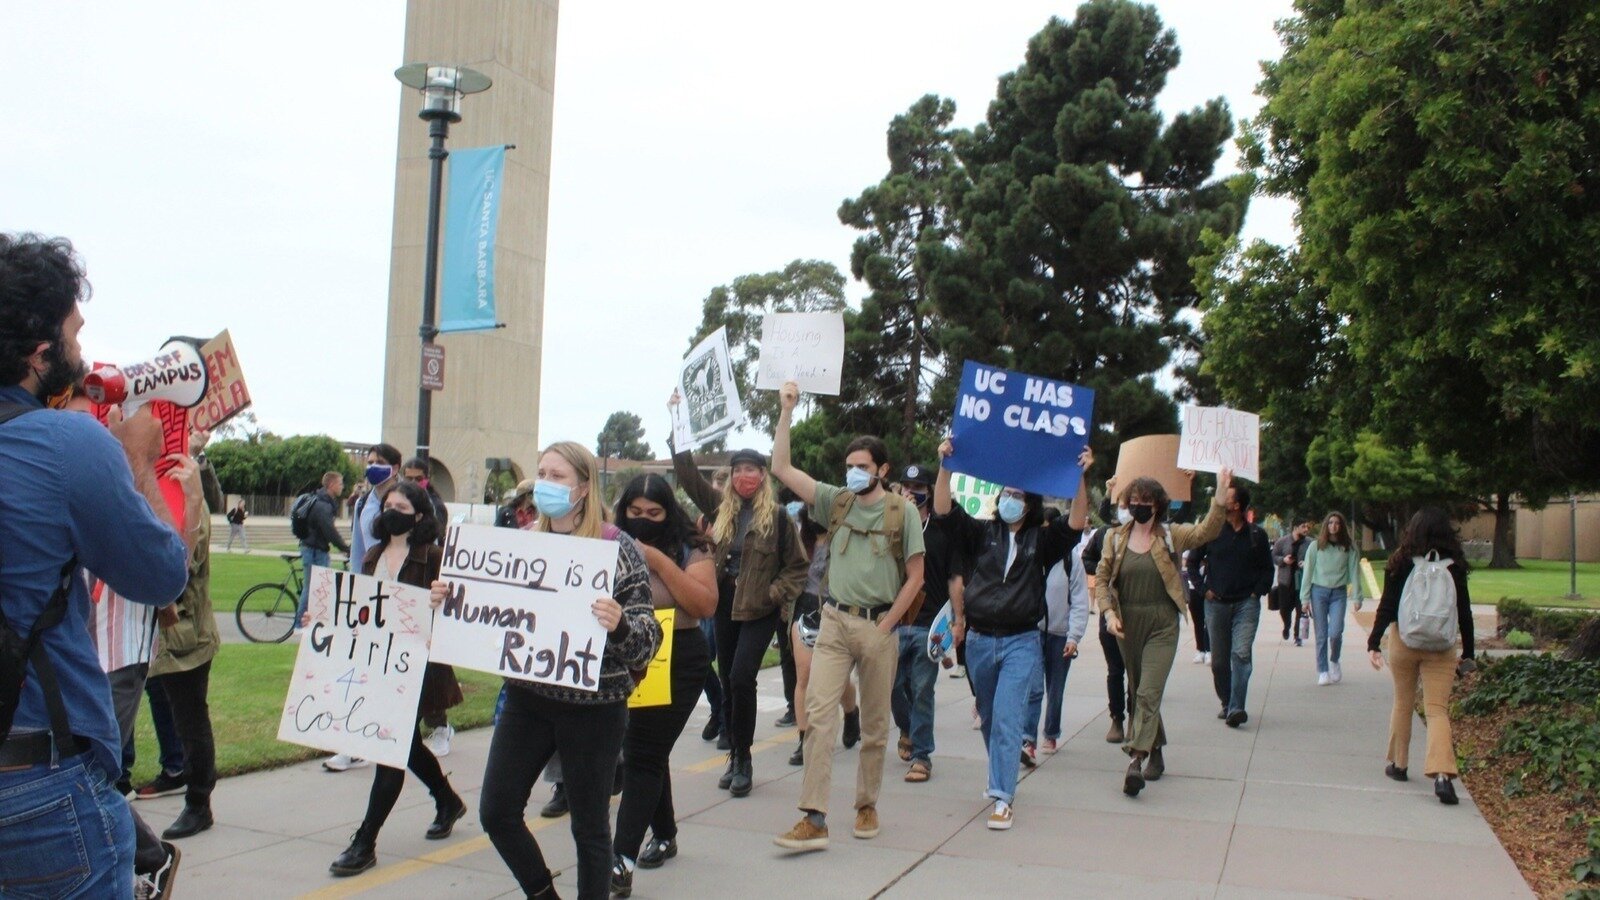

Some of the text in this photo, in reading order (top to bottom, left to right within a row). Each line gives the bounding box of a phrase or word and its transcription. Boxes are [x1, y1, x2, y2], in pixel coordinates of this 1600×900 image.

[477, 169, 495, 309] UC SANTA BARBARA
[770, 320, 821, 348] Housing
[123, 350, 182, 379] COPS OFF
[134, 363, 202, 395] CAMPUS
[974, 368, 1073, 408] UC HAS
[193, 379, 247, 432] COLA
[959, 394, 1086, 437] NO CLASS
[442, 525, 610, 593] Housing is a
[334, 572, 389, 628] Hot
[442, 581, 537, 633] Human
[311, 622, 410, 674] Girls
[499, 630, 598, 687] Right
[336, 667, 366, 702] 4
[295, 694, 397, 743] Cola
